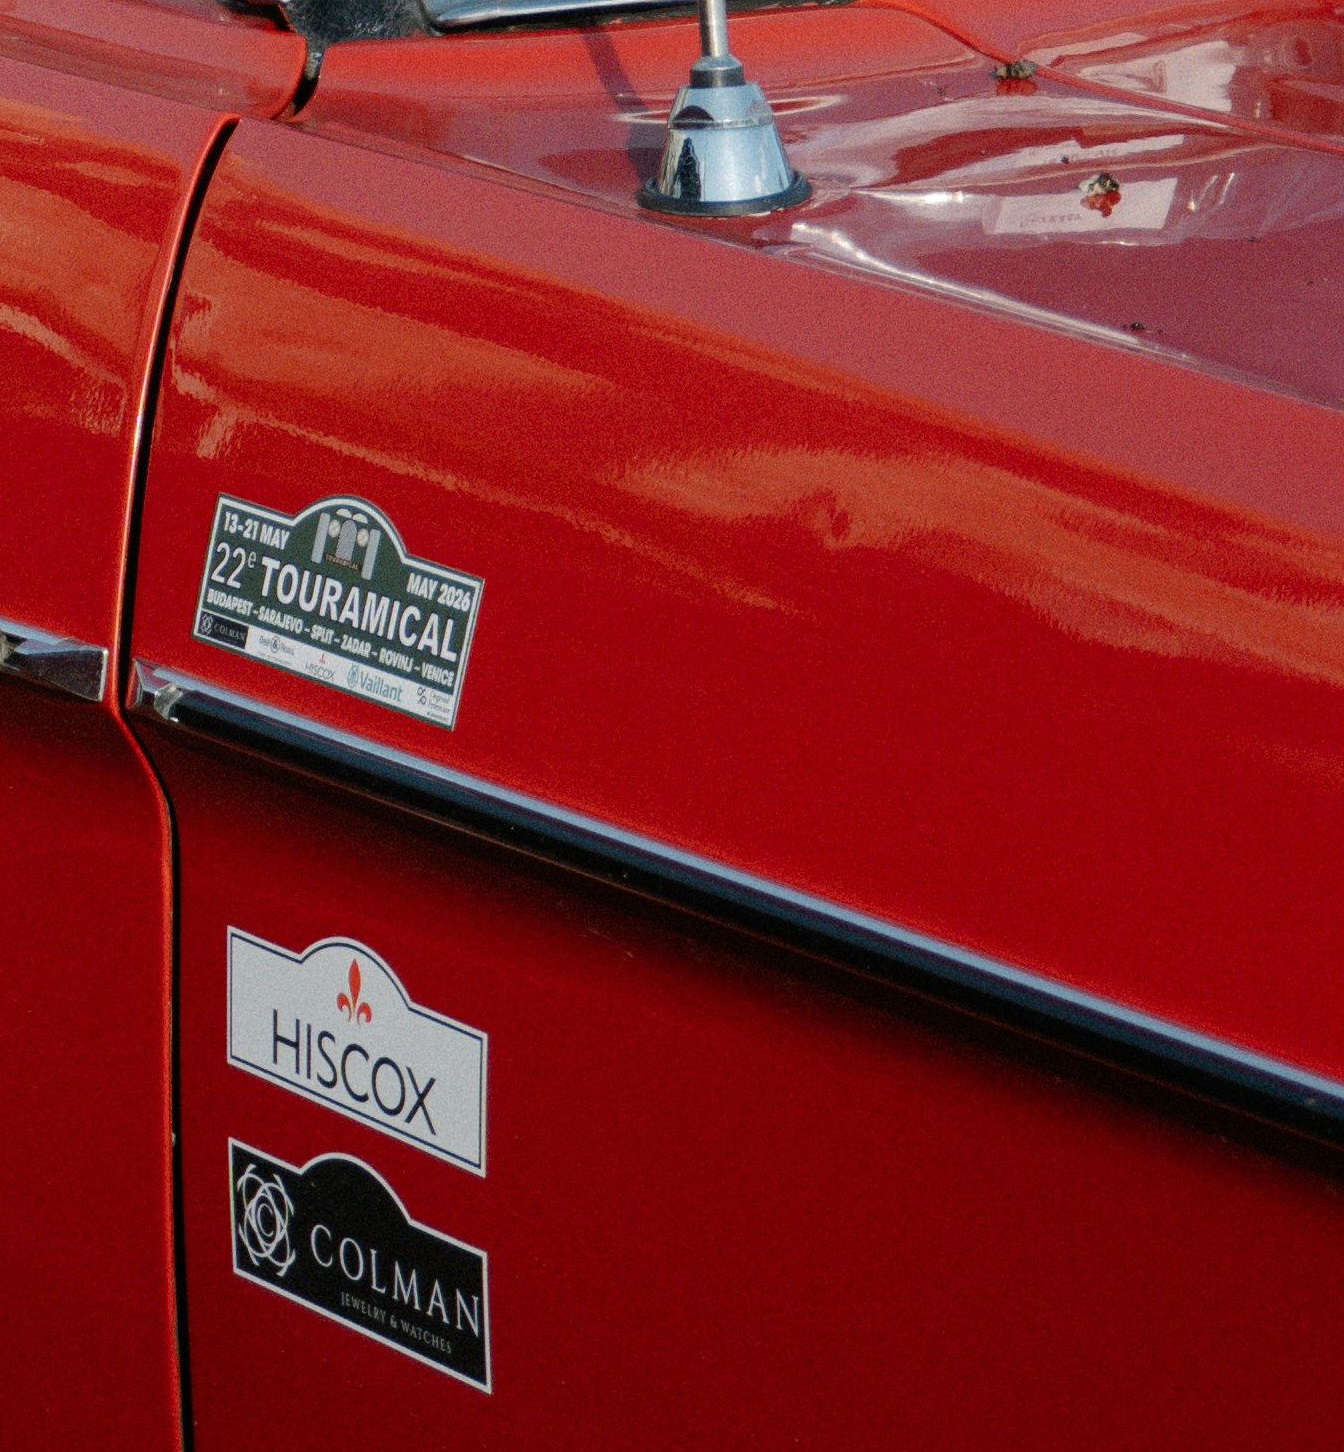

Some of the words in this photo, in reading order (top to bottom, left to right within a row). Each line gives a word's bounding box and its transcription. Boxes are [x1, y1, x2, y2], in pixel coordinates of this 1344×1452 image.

[224, 511, 260, 541] 13-21
[259, 523, 290, 551] MAY
[261, 555, 457, 662] TOURAMICAL
[407, 572, 437, 601] MAY
[436, 583, 472, 613] 2026
[207, 589, 254, 617] BUDAPEST
[258, 605, 303, 634] SARAJEVO
[310, 624, 335, 645] SPLIT
[341, 634, 371, 658] ZADAR
[379, 647, 413, 673] ROVINJ
[422, 662, 455, 687] VENICE
[305, 659, 336, 683] HISCOX
[359, 671, 403, 702] Vaillant
[272, 1008, 437, 1136] HISCOX
[311, 1223, 480, 1339] COLMAN
[341, 1291, 387, 1324] JEWELRY
[389, 1314, 398, 1329] &
[400, 1319, 452, 1355] WATCHES
